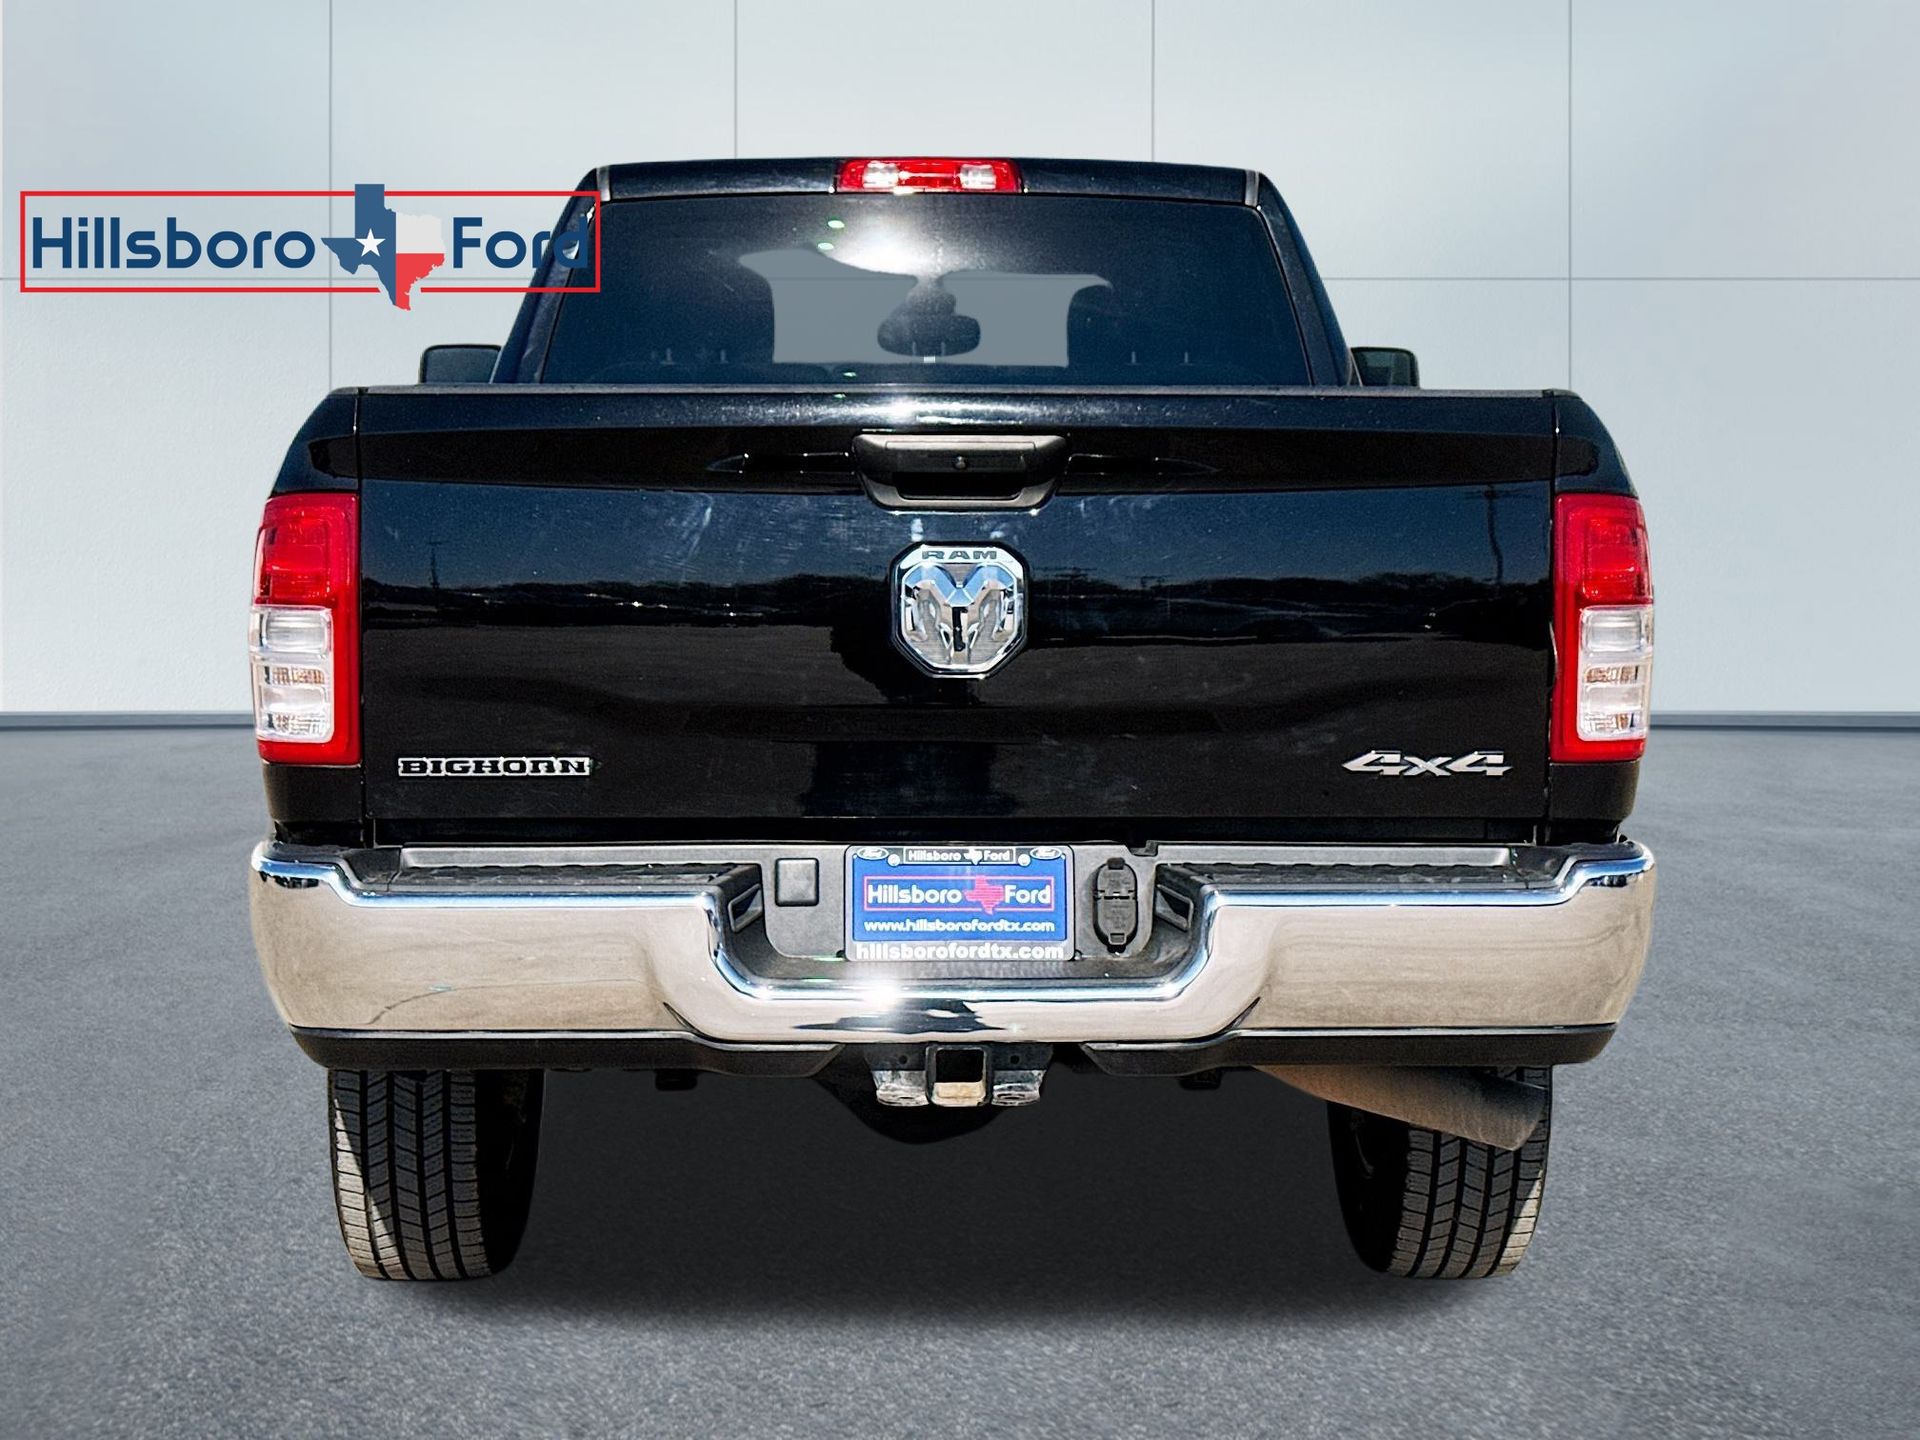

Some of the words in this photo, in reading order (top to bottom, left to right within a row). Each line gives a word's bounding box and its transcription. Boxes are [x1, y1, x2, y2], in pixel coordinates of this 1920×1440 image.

[921, 550, 998, 560] RAM
[398, 757, 590, 776] BIGHORN
[1342, 751, 1513, 776] 4x4
[908, 849, 962, 862] Hillsboro
[983, 849, 1011, 862] Ford
[867, 884, 963, 904] Hillsboro
[1004, 884, 1051, 904] Ford
[864, 918, 1055, 932] www.hillsborofordtx.com
[856, 942, 1064, 960] hillsborofordtx.com
